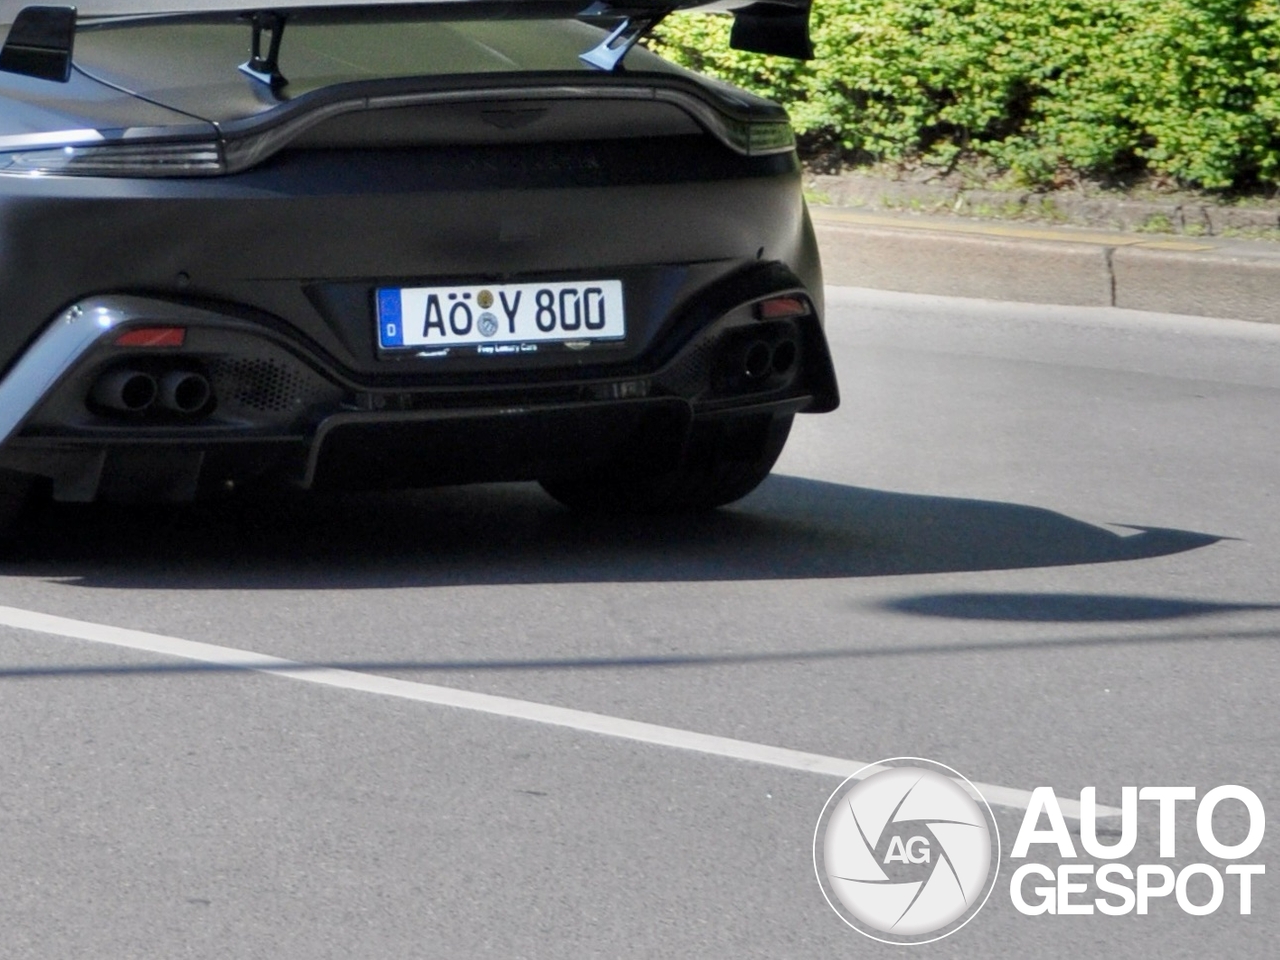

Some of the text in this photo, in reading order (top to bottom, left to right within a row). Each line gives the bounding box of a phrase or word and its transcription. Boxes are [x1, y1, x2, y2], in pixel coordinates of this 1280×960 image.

[387, 287, 606, 338] D AÖ Y 800
